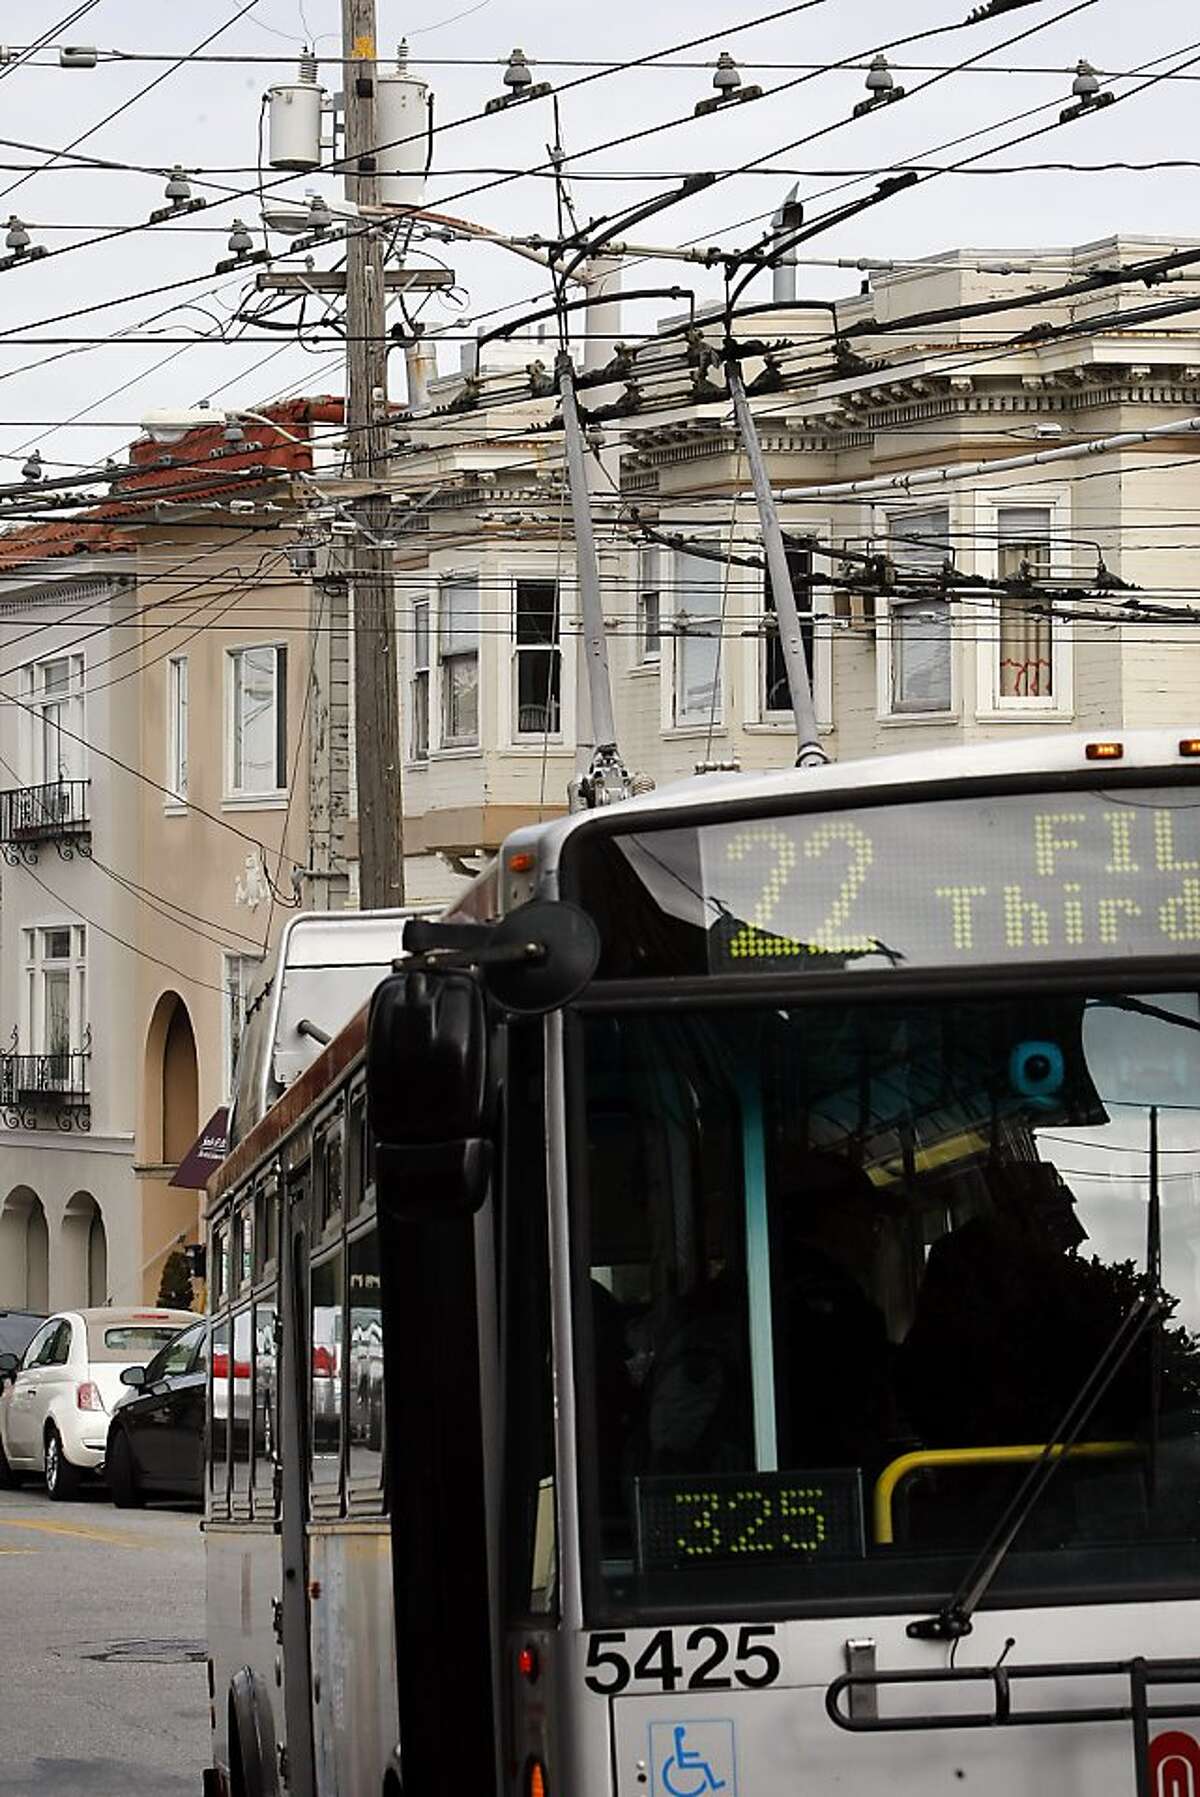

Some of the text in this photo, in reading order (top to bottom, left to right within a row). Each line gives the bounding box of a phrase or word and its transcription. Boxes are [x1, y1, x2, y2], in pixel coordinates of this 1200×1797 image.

[727, 822, 877, 957] 22
[936, 878, 1200, 949] Third
[675, 1489, 824, 1554] 325
[585, 1625, 780, 1695] 5425
